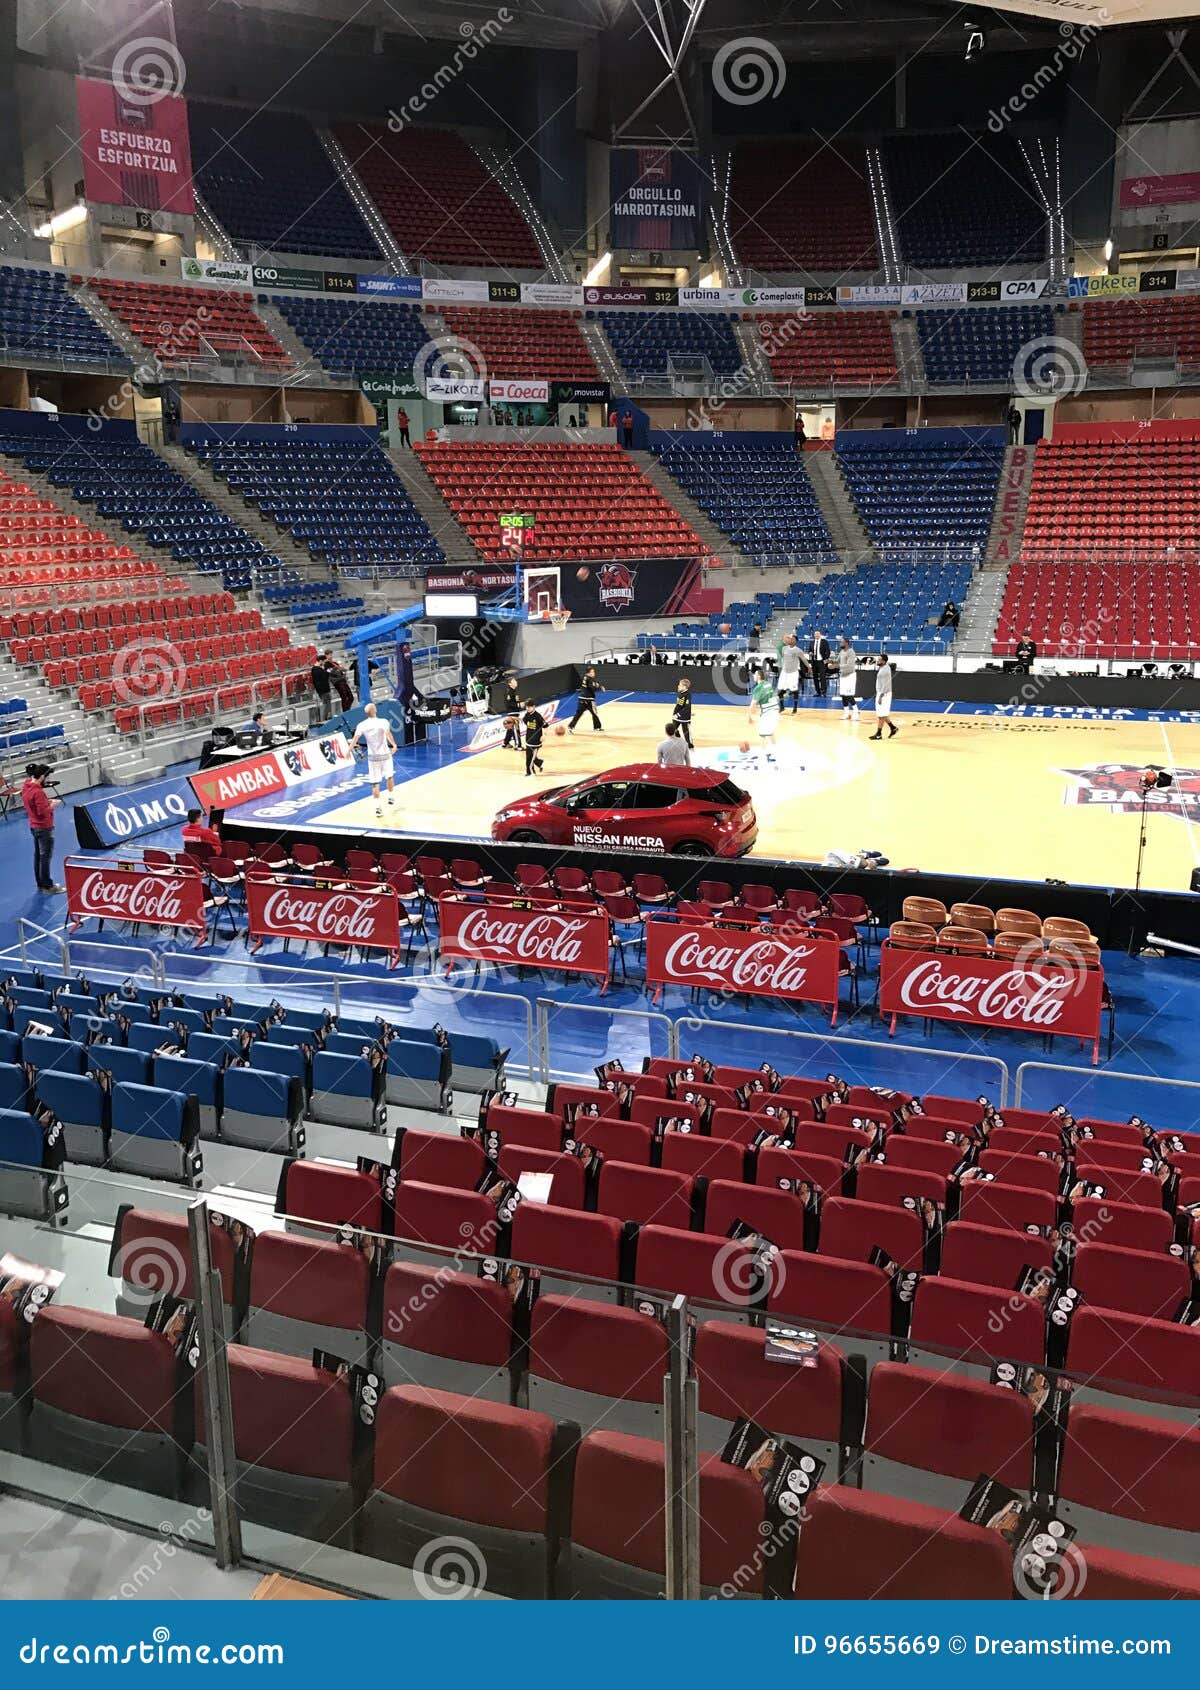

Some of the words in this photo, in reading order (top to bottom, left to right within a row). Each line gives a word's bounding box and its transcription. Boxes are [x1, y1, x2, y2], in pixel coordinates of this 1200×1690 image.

[100, 129, 171, 154] ESFUERZO
[98, 147, 178, 174] ESFORTZUA
[629, 187, 682, 201] ORGULLO
[614, 203, 696, 217] HARROTASUNA
[141, 215, 149, 227] 6
[254, 267, 278, 280] EKO
[328, 278, 354, 288] 311-A
[1090, 276, 1137, 291] oketa
[1149, 276, 1167, 286] 314
[491, 287, 517, 297] 311-B
[683, 289, 720, 300] urbina
[856, 287, 899, 295] JEDSA
[970, 287, 998, 297] 313-B
[1006, 282, 1036, 295] CPA
[655, 292, 672, 301] 312
[760, 292, 804, 303] Comeplastic
[807, 292, 834, 301] 313-A
[507, 384, 547, 400] Coeca
[574, 388, 605, 397] movistar
[502, 527, 523, 546] 24
[219, 764, 281, 802] AMBAR
[129, 793, 188, 829] IMQ
[573, 825, 603, 834] NUEVO
[574, 833, 620, 845] NISSAN
[623, 836, 665, 848] MICRA
[80, 871, 186, 919] Coca-Cola
[264, 888, 381, 938] Coca-Cola
[458, 908, 590, 962] Coca-Cola
[665, 931, 817, 991] Coca-Cola
[900, 960, 1077, 1025] Coca-Cola
